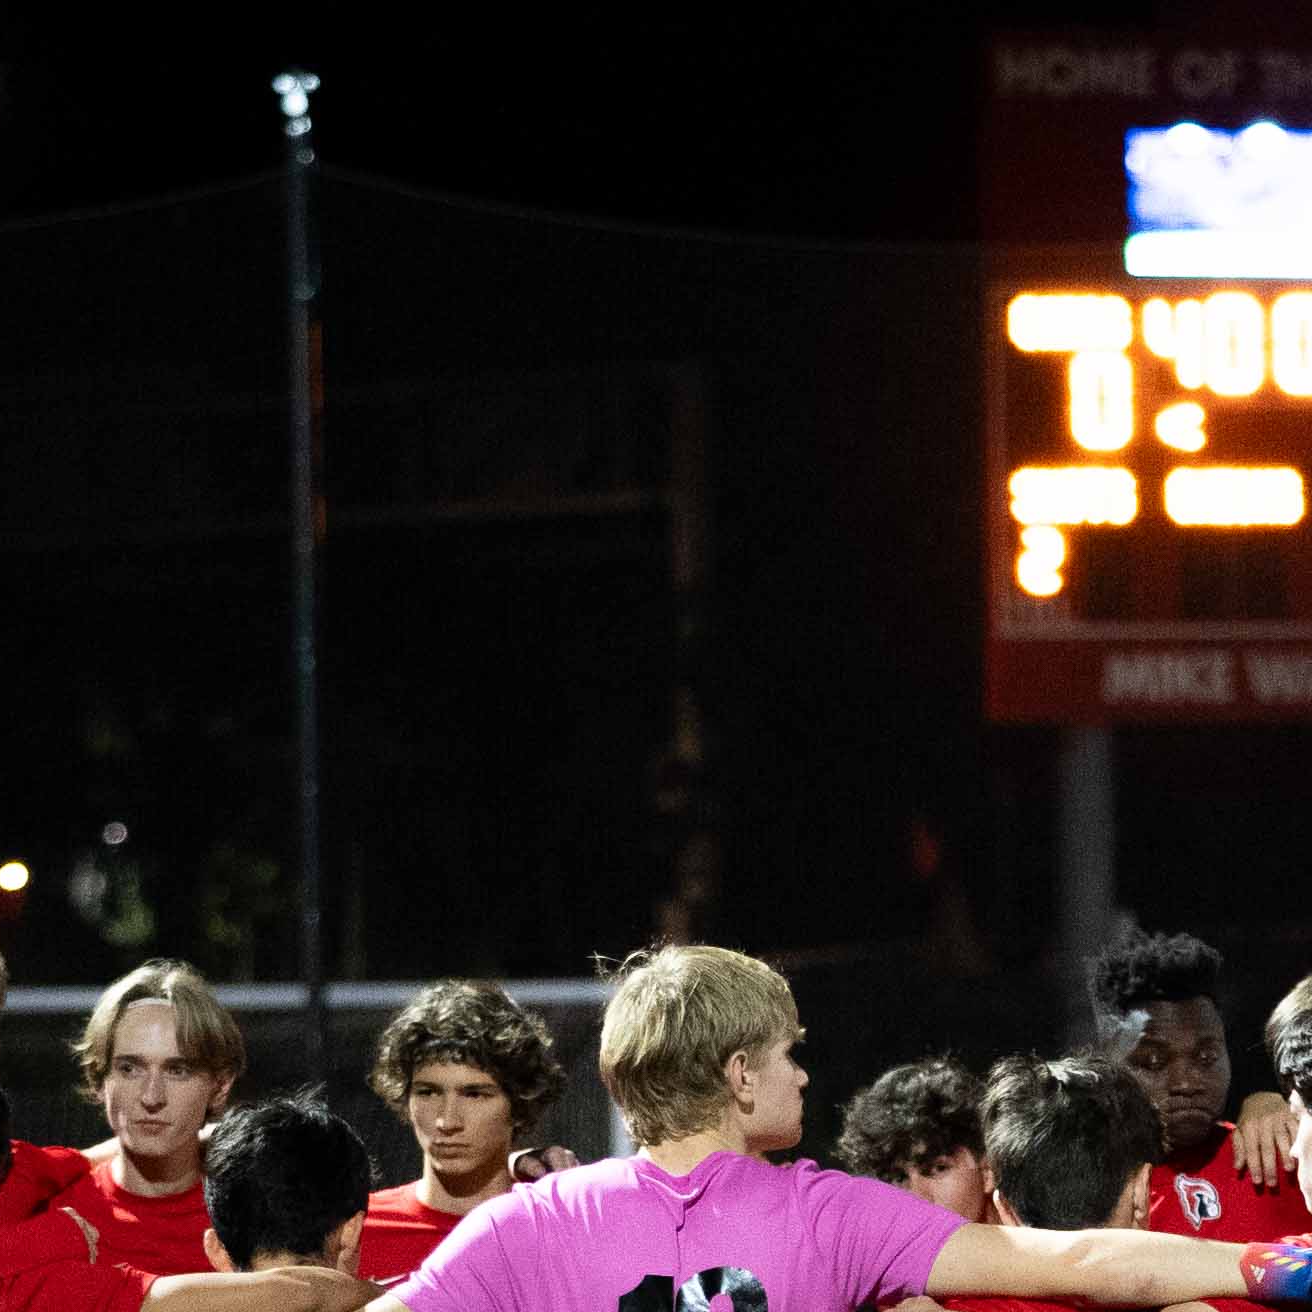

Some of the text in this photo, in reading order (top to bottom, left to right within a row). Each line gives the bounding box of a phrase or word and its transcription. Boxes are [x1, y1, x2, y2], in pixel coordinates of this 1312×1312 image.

[998, 49, 1155, 96] HOME
[1174, 50, 1239, 97] OF
[1101, 650, 1231, 703] MIKE
